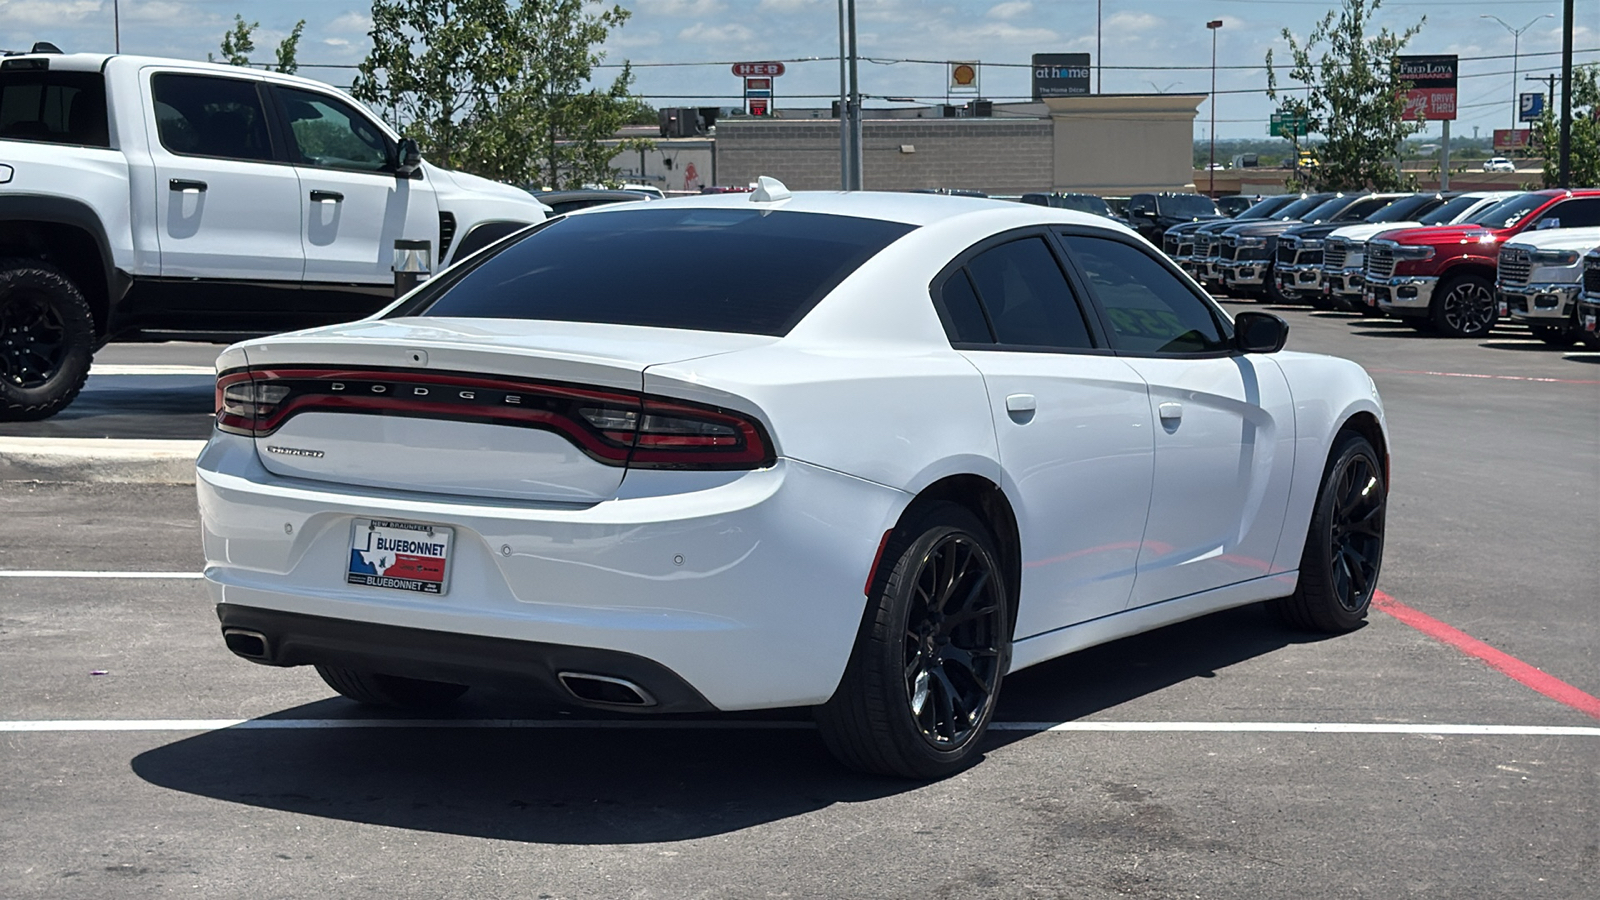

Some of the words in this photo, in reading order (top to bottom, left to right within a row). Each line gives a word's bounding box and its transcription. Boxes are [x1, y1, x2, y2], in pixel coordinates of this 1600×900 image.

[1035, 67, 1049, 78] at
[1051, 67, 1089, 78] home
[1400, 63, 1426, 73] FRED
[1427, 63, 1453, 73] LOYA
[1431, 93, 1454, 103] DRIVE
[1431, 103, 1455, 113] THRU
[331, 382, 521, 404] DODGE
[377, 538, 445, 556] BLUEBONNET
[366, 576, 422, 590] BLUEBONNET
